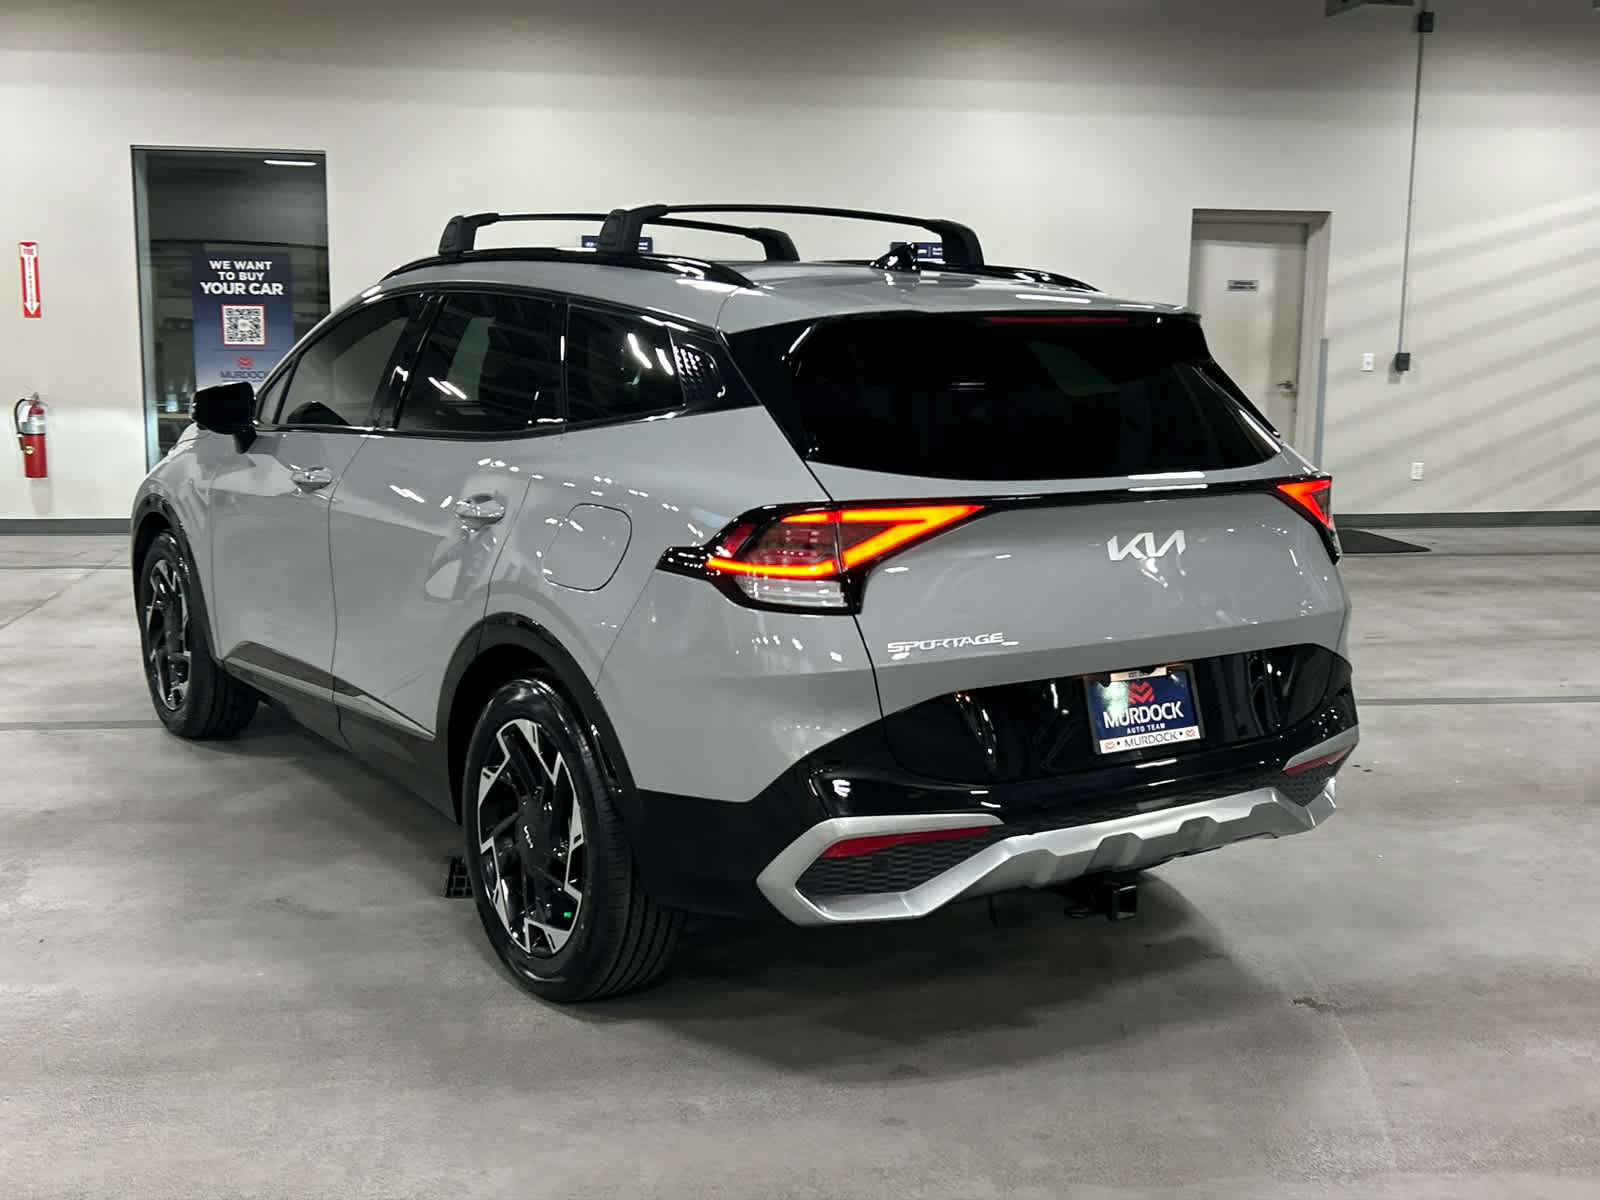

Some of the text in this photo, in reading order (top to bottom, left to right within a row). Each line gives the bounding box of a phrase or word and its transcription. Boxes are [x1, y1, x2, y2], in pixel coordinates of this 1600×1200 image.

[209, 260, 273, 270] WE WANT
[218, 271, 265, 281] TO BUY
[200, 281, 284, 295] YOUR CAR
[1107, 529, 1187, 562] KIA
[887, 631, 1004, 653] SPORTAGE
[1102, 700, 1185, 729] MURDOCK
[1126, 722, 1166, 735] AUTO TEAM
[1123, 731, 1179, 749] MURDOCK
